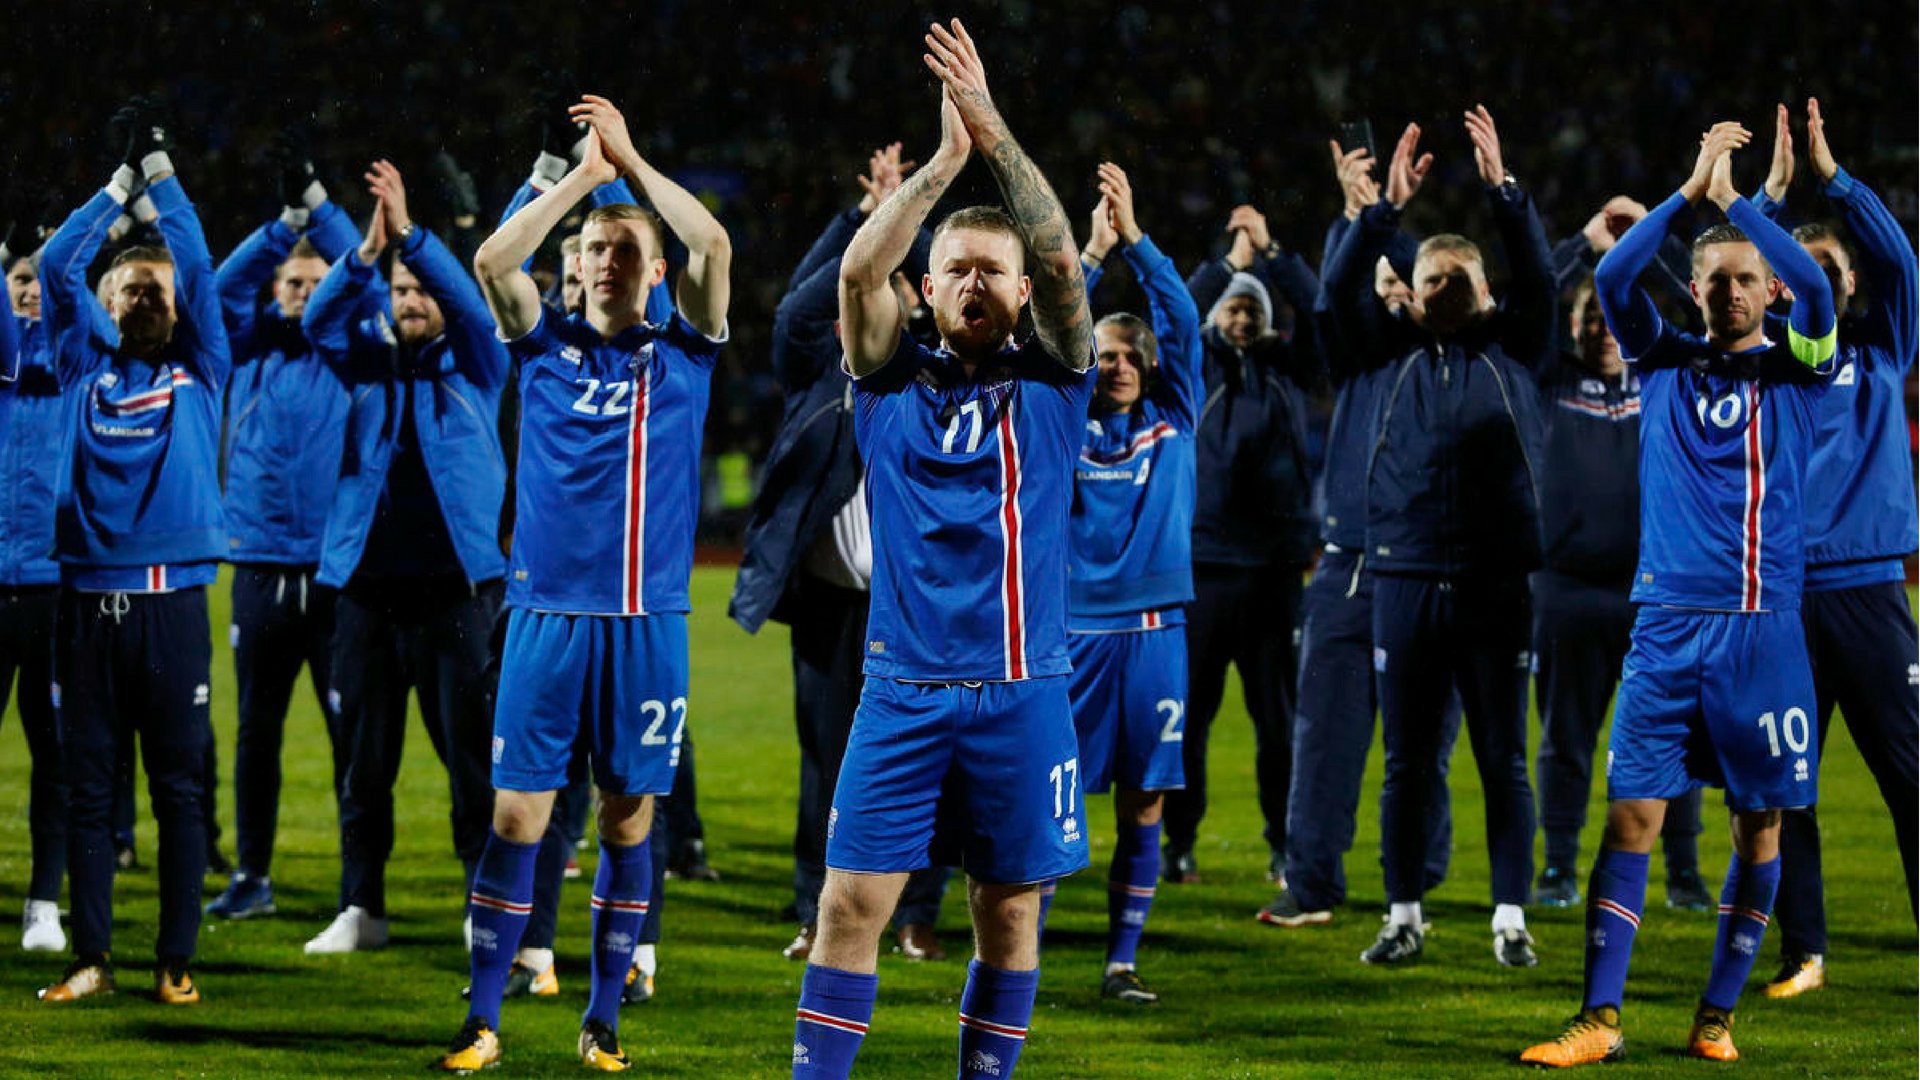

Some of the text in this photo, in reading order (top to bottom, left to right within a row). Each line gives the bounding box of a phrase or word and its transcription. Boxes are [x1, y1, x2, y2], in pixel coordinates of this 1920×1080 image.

[573, 379, 629, 415] 22
[1697, 393, 1741, 428] 10
[1156, 699, 1184, 741] 2
[1758, 707, 1809, 757] 10
[1050, 758, 1077, 818] 17
